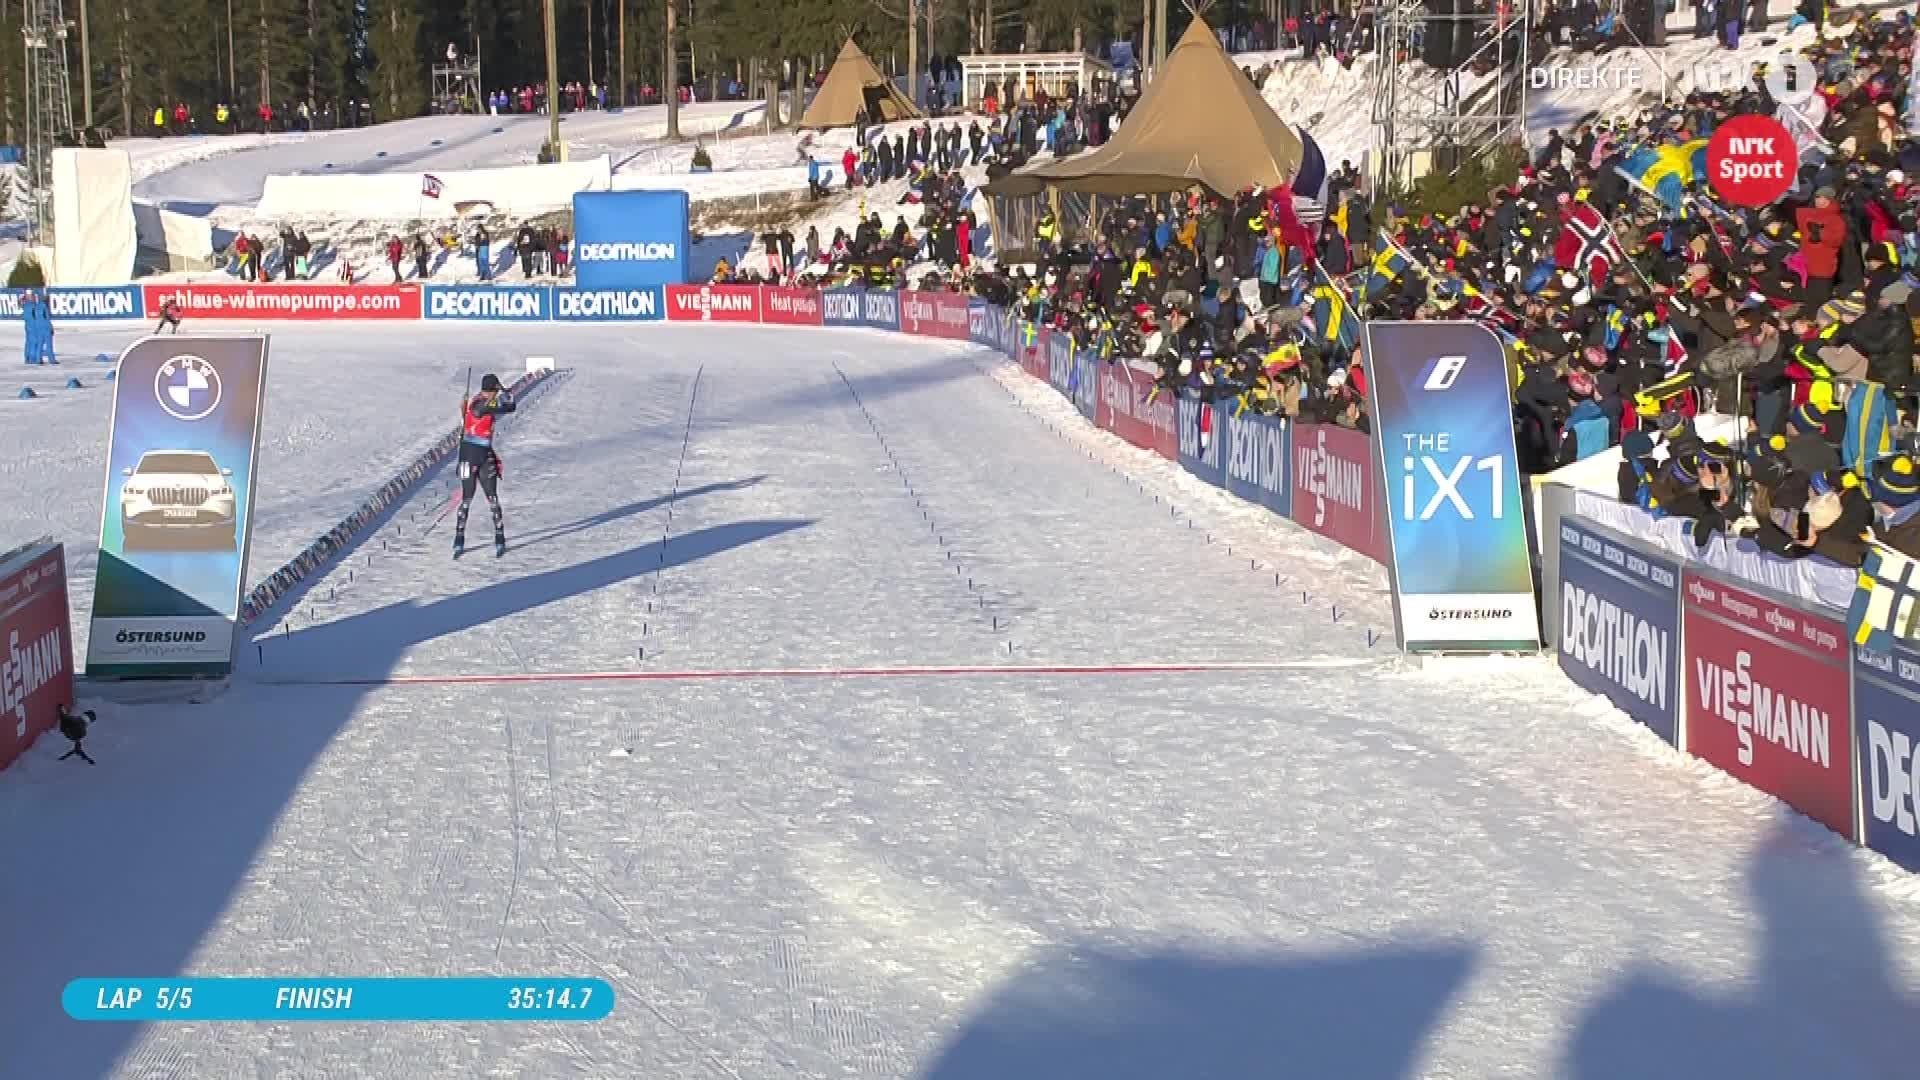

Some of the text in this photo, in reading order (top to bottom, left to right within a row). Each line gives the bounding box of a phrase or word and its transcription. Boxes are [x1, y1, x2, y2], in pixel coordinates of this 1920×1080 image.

[580, 243, 675, 261] DECATHLON
[51, 292, 133, 313] DECATHLON
[431, 292, 540, 316] DECATHLON
[559, 291, 655, 316] DECATHLON
[770, 292, 791, 312] Heat
[1402, 433, 1450, 451] THE
[1404, 455, 1504, 521] iX1
[1428, 603, 1513, 620] ÖSTERSUND
[116, 627, 206, 643] ÖSTERSUND
[1563, 581, 1667, 711] DECATHLON
[1696, 650, 1830, 769] VIESSMANN
